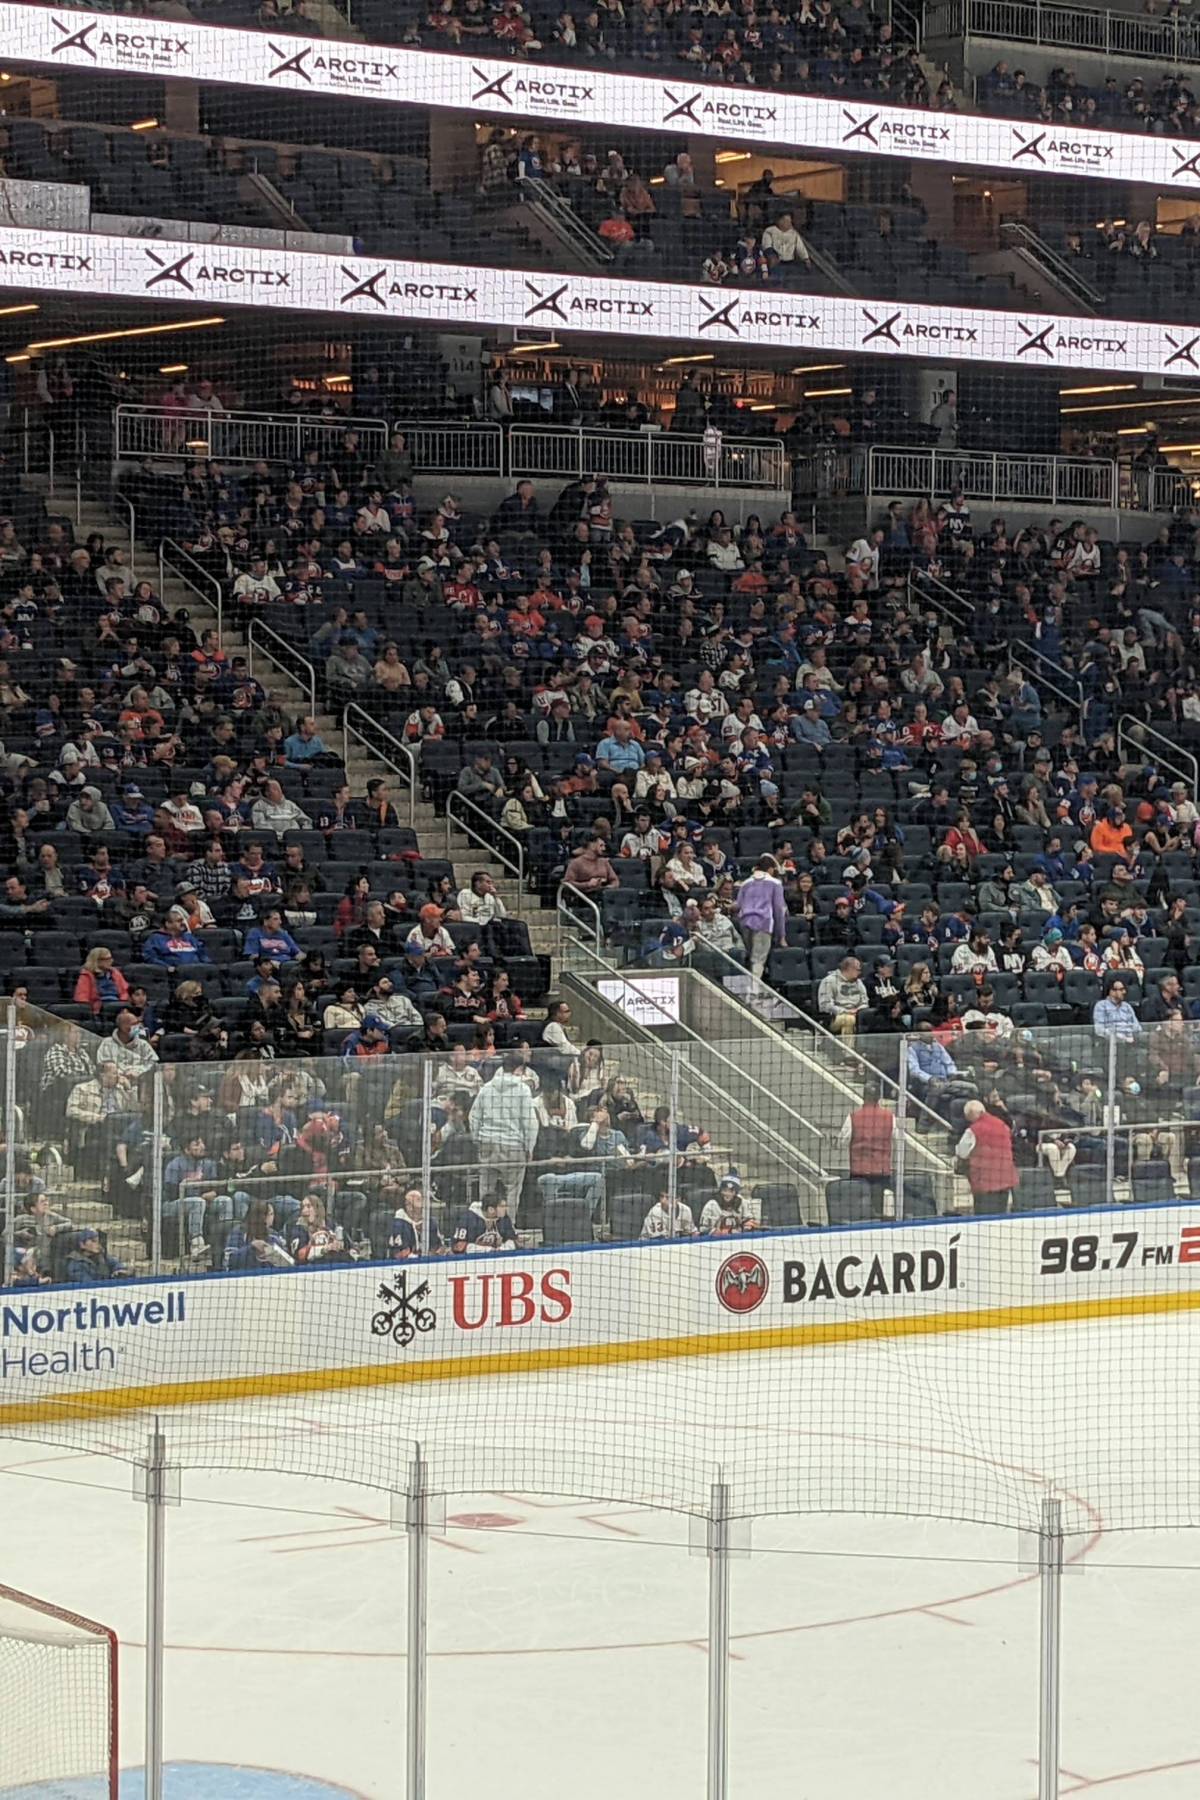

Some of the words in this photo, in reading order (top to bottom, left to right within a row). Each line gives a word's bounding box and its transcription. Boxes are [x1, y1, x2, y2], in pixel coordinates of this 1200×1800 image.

[100, 32, 189, 54] ARCTIX
[314, 56, 398, 78] ARCTIX
[515, 80, 594, 100] ARCTIX
[703, 102, 777, 120] ARCTIX
[881, 122, 950, 140] ARCTIX
[1048, 141, 1114, 159] ARCTIX
[197, 268, 290, 287] ARCTIX
[389, 284, 478, 302] ARCTIX
[570, 297, 653, 316] ARCTIX
[741, 312, 820, 330] ARCTIX
[903, 324, 977, 341] ARCTIX
[1056, 336, 1126, 353] ARCTIX
[452, 358, 474, 373] 114
[932, 390, 944, 404] 11
[1003, 953, 1025, 974] NY
[627, 994, 676, 1006] ARCTIX
[1040, 1231, 1138, 1275] 98.7
[1142, 1244, 1173, 1266] FM
[782, 1232, 962, 1304] BACARDÍ
[448, 1268, 572, 1330] UBS
[2, 1291, 185, 1336] Northwell
[2, 1339, 115, 1378] Health
